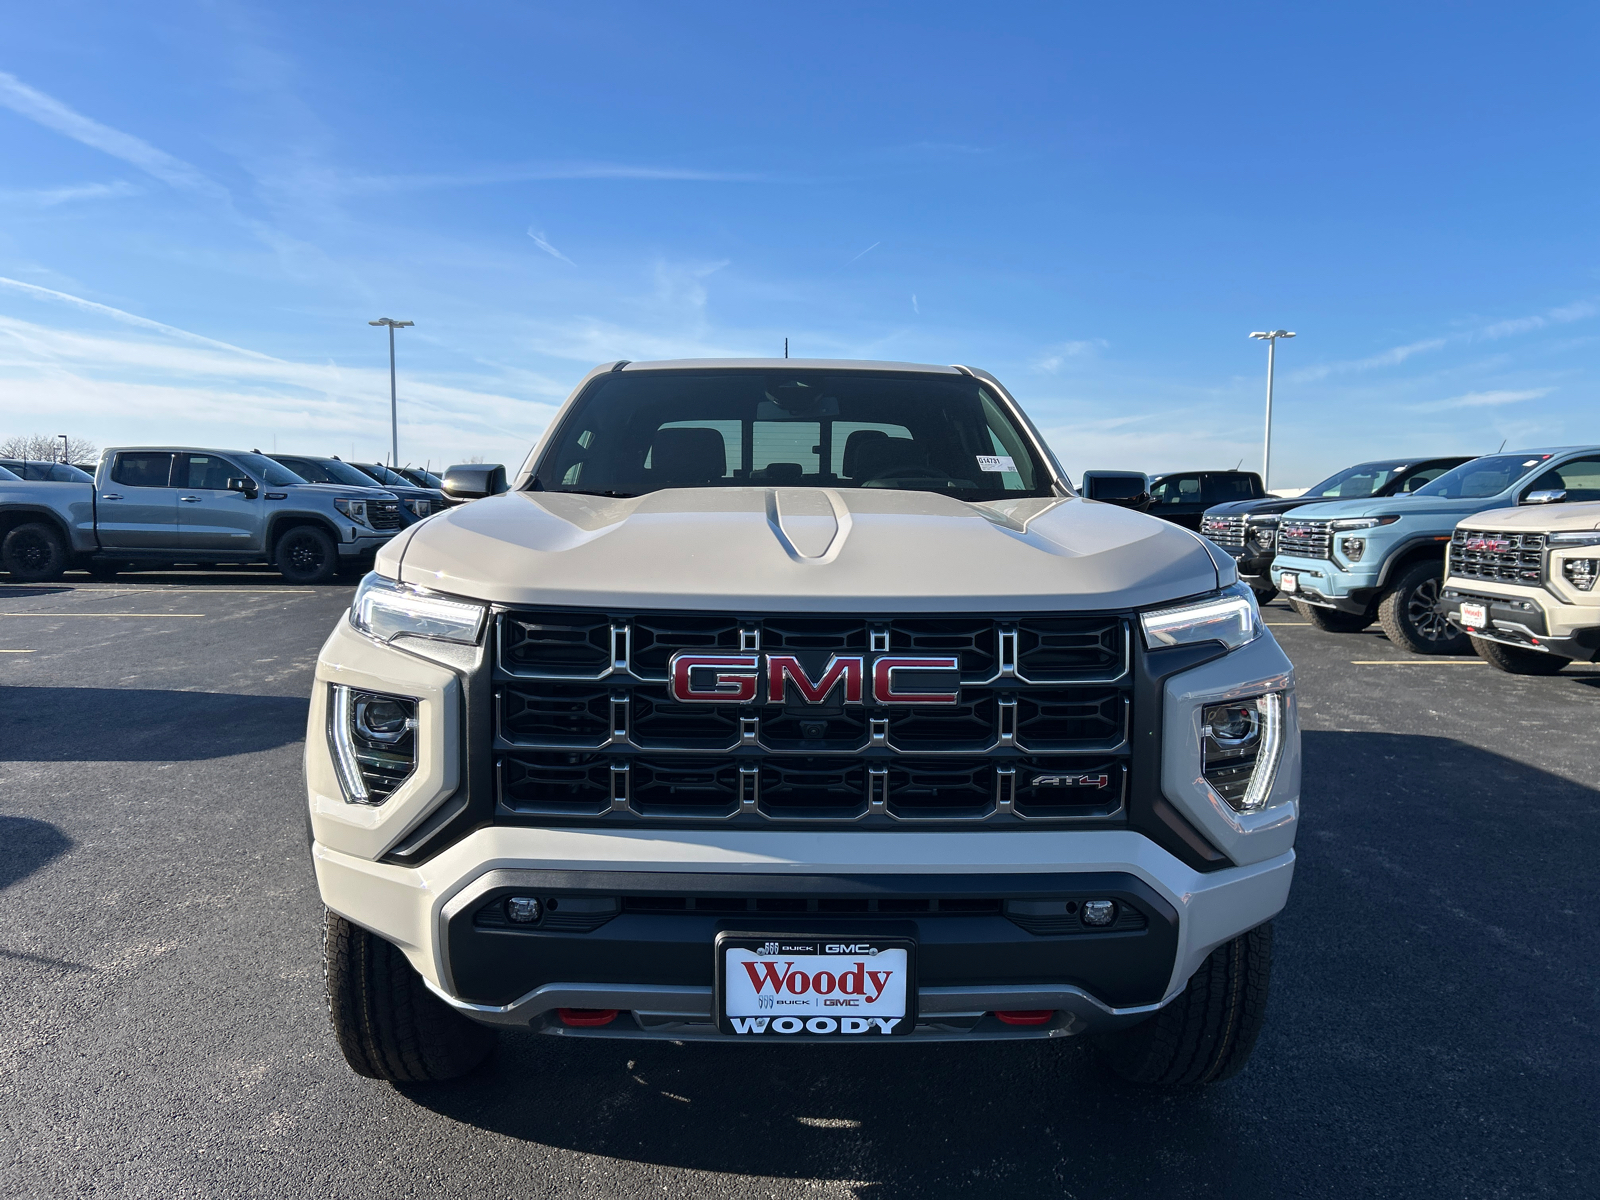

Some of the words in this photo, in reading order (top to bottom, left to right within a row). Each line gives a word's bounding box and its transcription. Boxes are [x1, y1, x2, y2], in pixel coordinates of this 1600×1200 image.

[668, 651, 960, 705] GMC
[1032, 774, 1108, 789] AT4
[825, 944, 870, 954] GMC
[741, 961, 893, 1003] Woody
[823, 998, 860, 1007] GMC
[730, 1017, 902, 1034] WOODY
